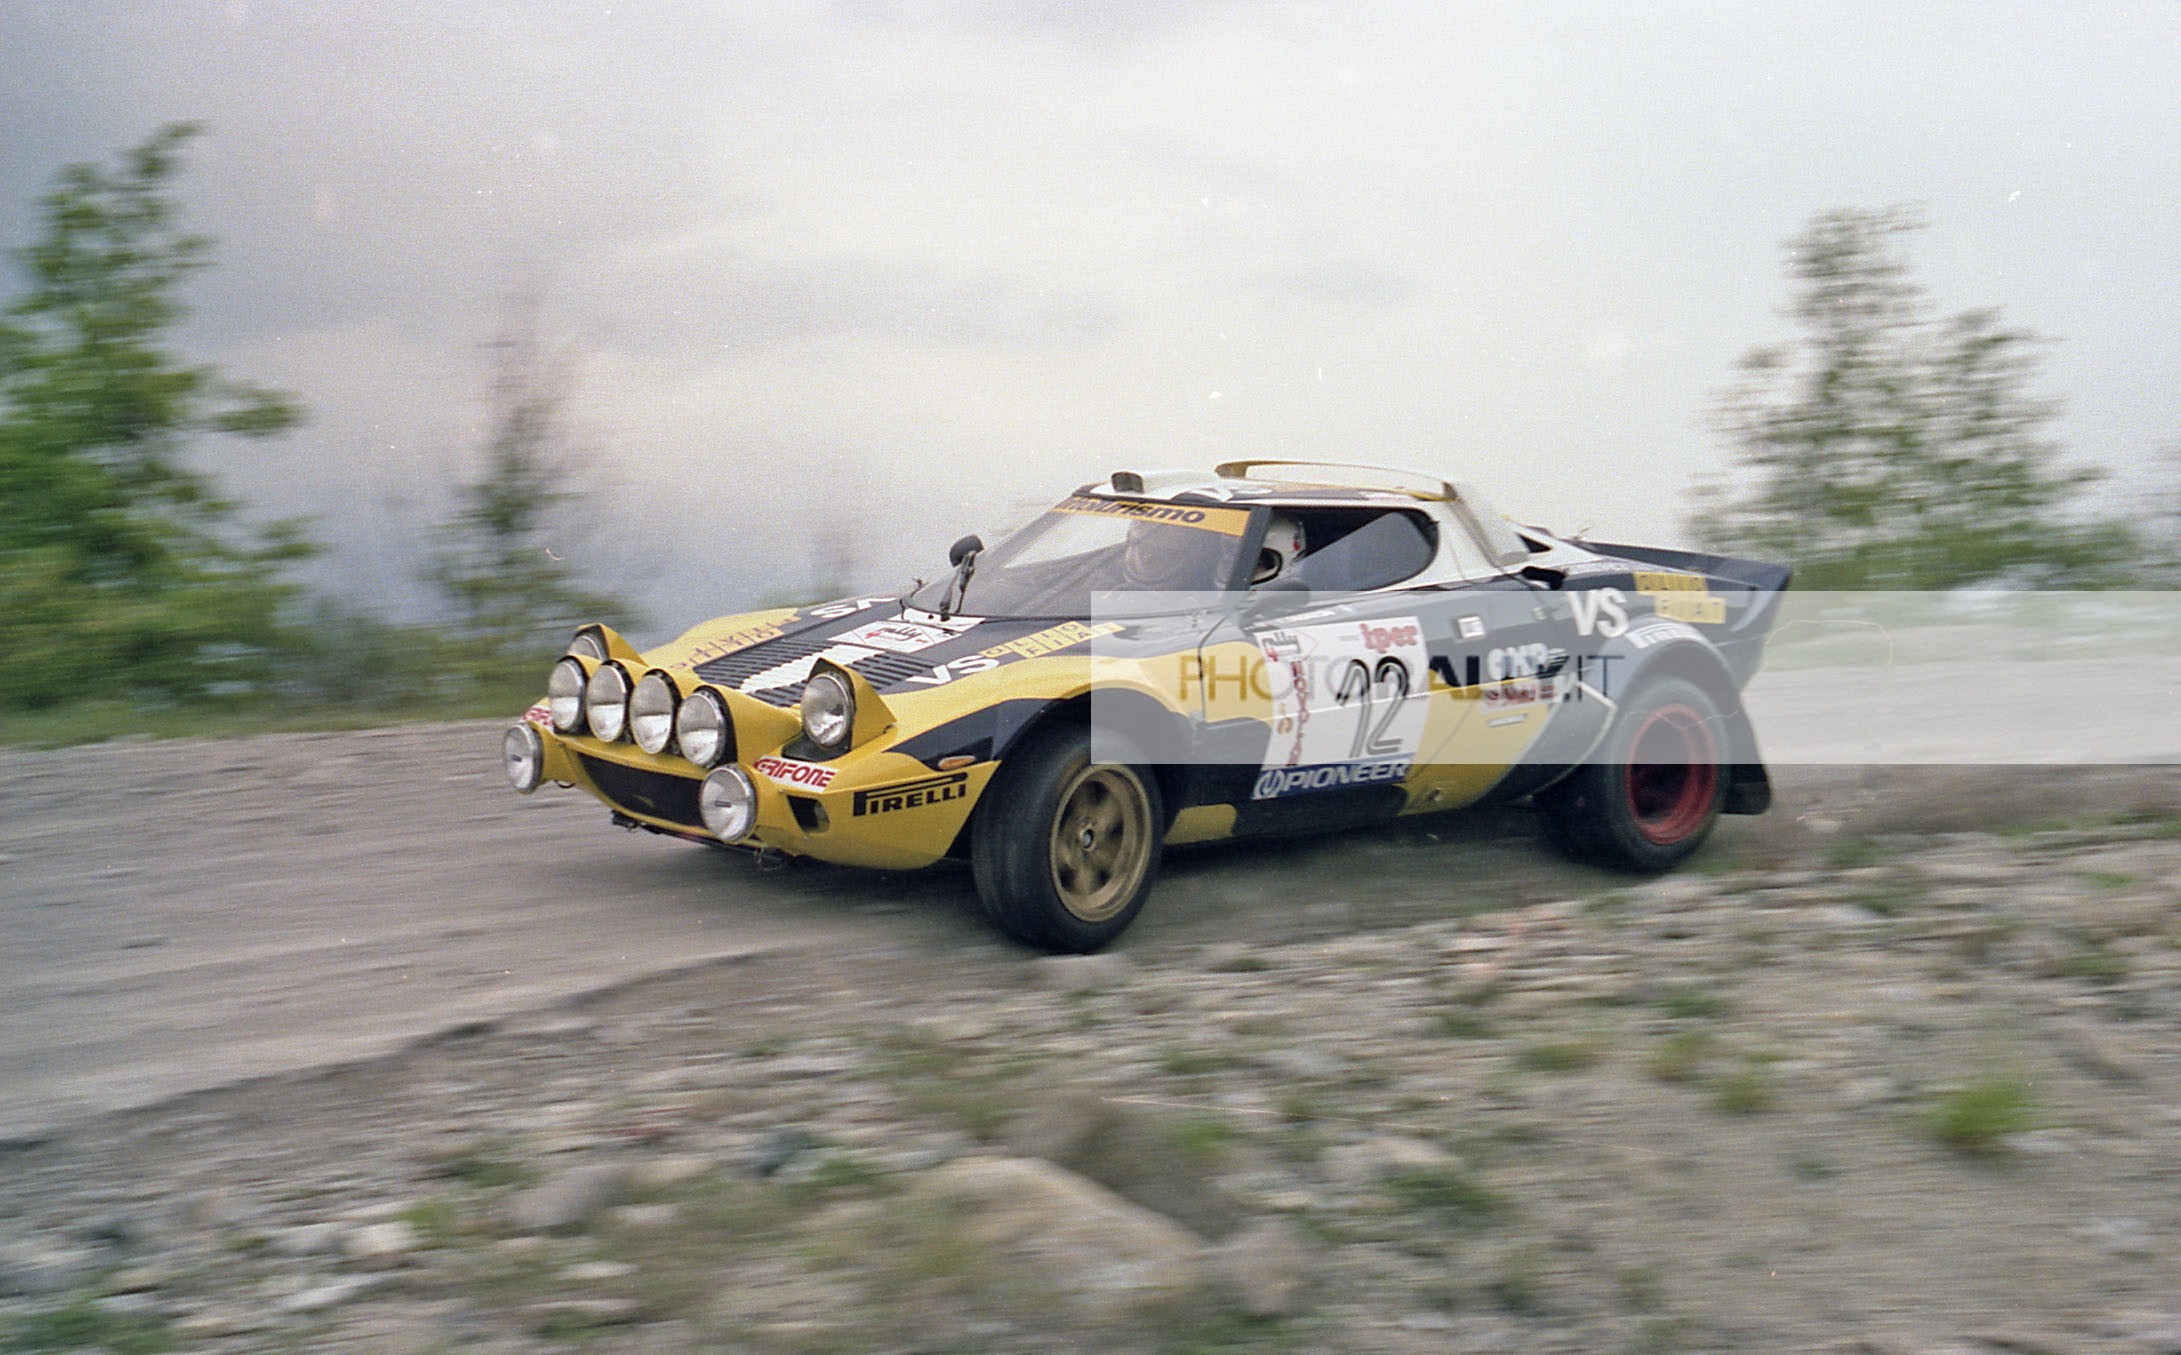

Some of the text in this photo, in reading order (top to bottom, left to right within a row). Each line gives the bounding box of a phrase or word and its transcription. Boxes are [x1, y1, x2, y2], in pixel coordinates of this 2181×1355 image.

[1566, 587, 1629, 638] VS
[906, 655, 999, 685] VS
[1337, 655, 1410, 758] 12
[753, 758, 836, 788] GRIFONE
[1281, 758, 1412, 792] PIONEER
[853, 772, 968, 816] PIRELLI
